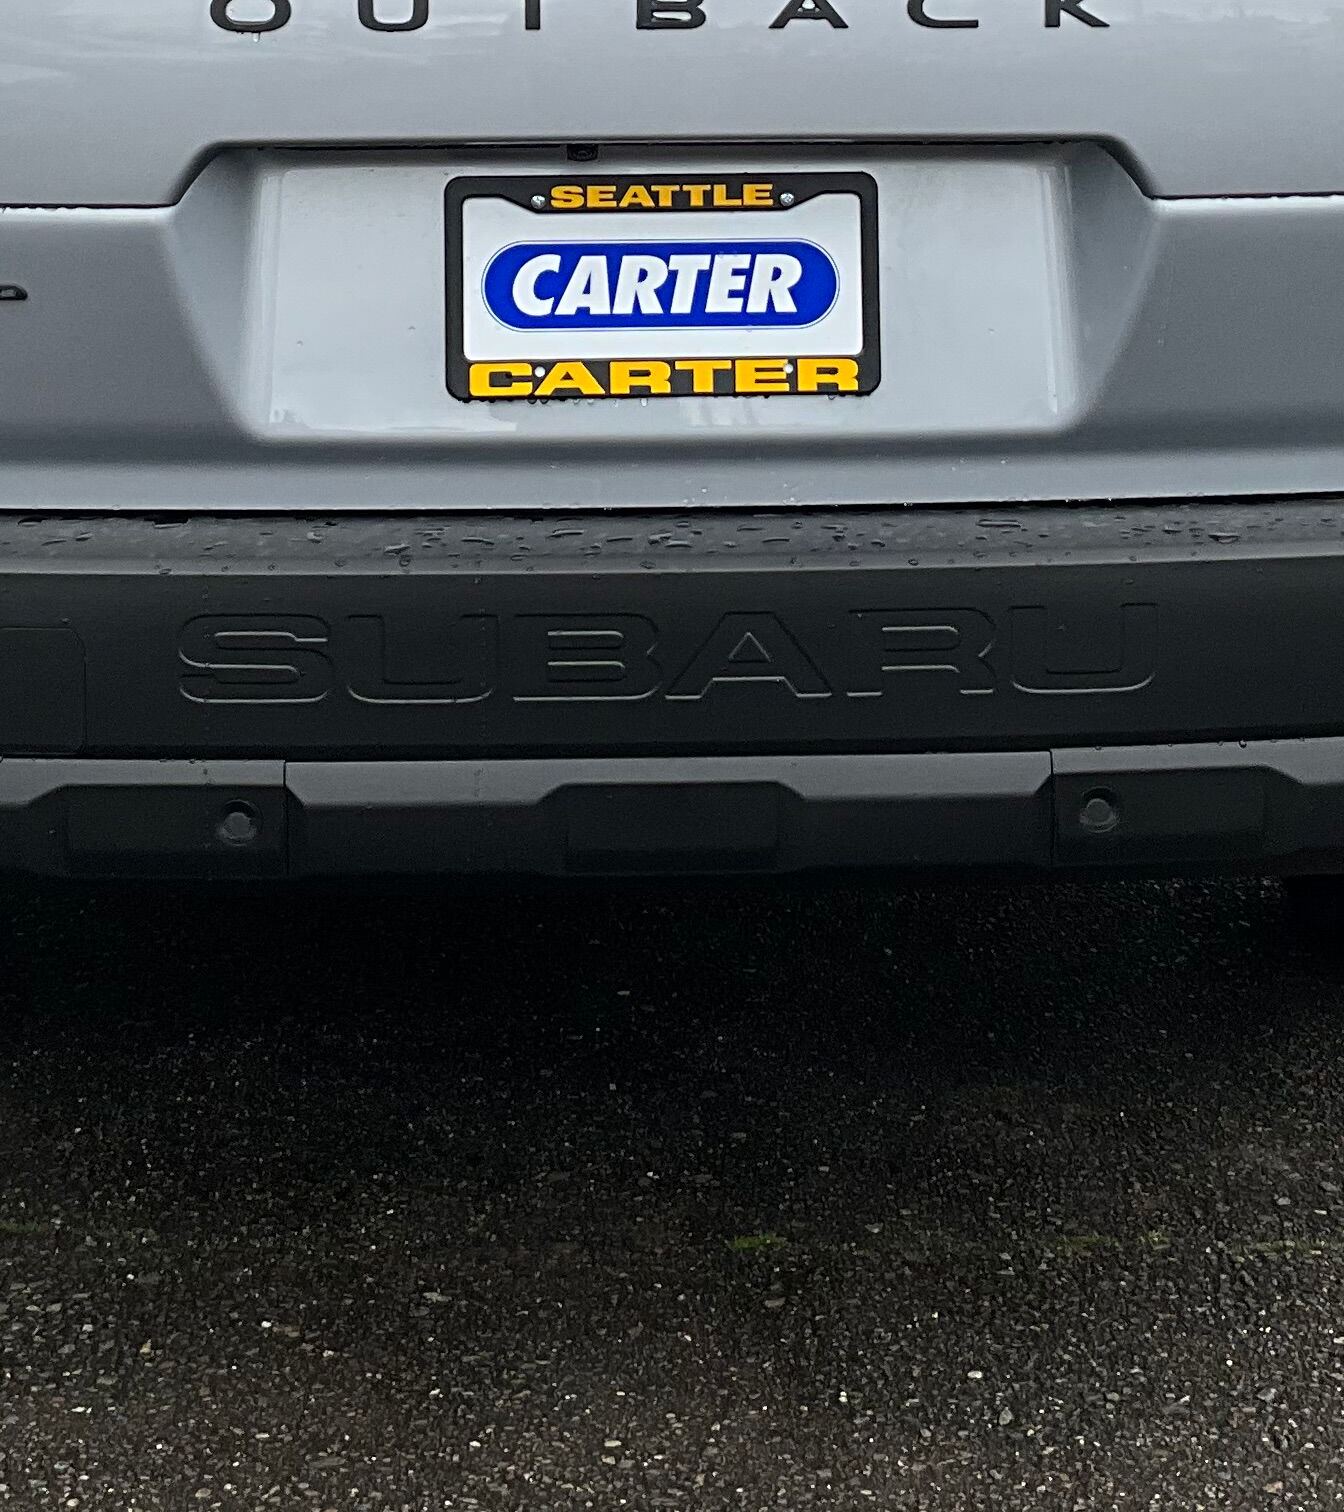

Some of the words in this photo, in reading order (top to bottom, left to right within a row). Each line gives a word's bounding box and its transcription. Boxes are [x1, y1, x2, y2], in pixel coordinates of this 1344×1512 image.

[550, 183, 774, 209] SEATTLE
[512, 252, 803, 317] CARTER
[468, 357, 860, 397] CARTER
[178, 601, 1160, 705] SUBARU
